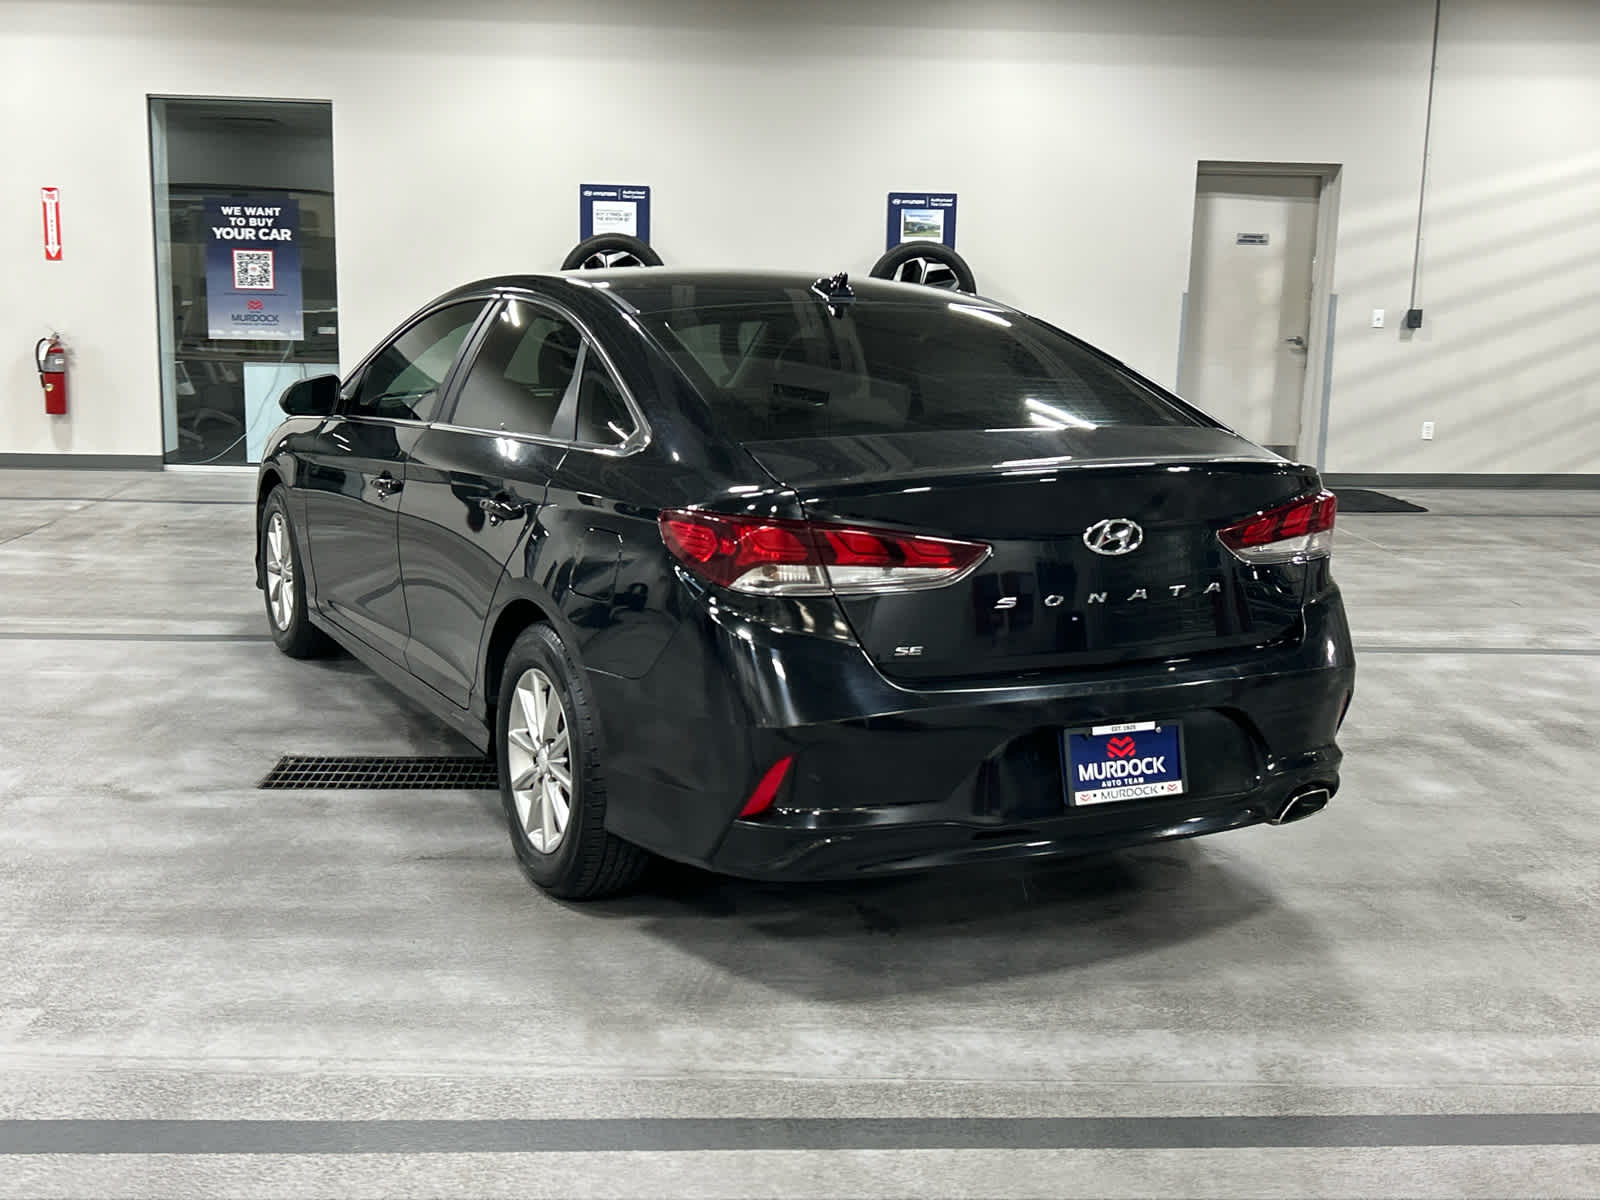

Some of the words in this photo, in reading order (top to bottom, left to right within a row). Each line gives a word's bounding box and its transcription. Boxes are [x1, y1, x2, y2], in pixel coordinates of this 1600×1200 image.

[221, 206, 242, 216] WE
[243, 206, 281, 217] WANT
[229, 217, 246, 226] TO
[248, 217, 274, 227] BUY
[212, 227, 256, 240] YOUR
[258, 228, 292, 241] CAR
[231, 313, 280, 323] MURDOCK
[994, 581, 1222, 609] SONATA
[894, 645, 924, 656] SE
[1078, 756, 1167, 782] MURDOCK
[1101, 779, 1122, 788] AUTO
[1124, 777, 1144, 785] TEAM
[1100, 785, 1159, 800] MURDOCK
